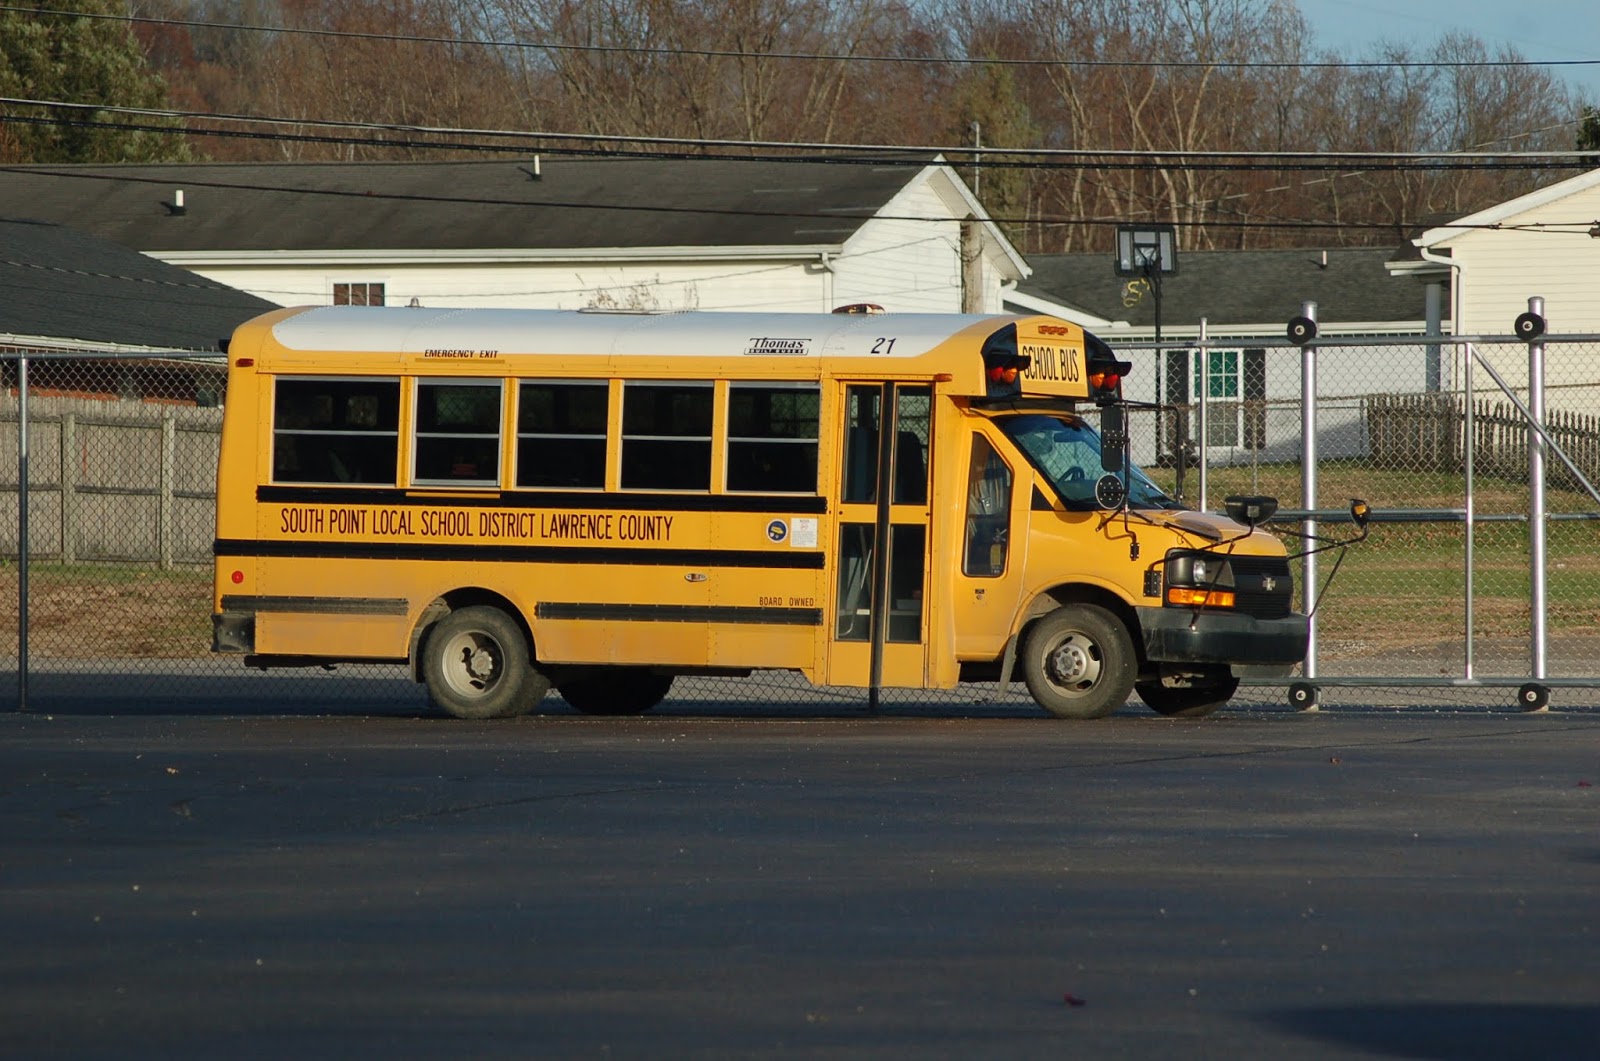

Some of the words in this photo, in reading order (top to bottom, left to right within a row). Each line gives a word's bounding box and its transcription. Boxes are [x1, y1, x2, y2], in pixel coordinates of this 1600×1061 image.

[750, 337, 812, 348] Thomas
[871, 337, 897, 354] 21
[424, 349, 475, 358] EMERGENCY
[479, 350, 498, 358] EXIT
[1022, 345, 1059, 381] SCHOOL
[1060, 348, 1079, 383] BUS
[281, 507, 324, 534] SOUTH
[329, 508, 367, 535] POINT
[372, 509, 415, 536] LOCAL
[420, 510, 474, 537] SCHOOL
[479, 511, 536, 539] DISTRICT
[540, 513, 613, 540] LAWRENCE
[618, 514, 674, 541] COUNTY
[759, 596, 783, 606] BOARD
[789, 597, 815, 607] OWNED
